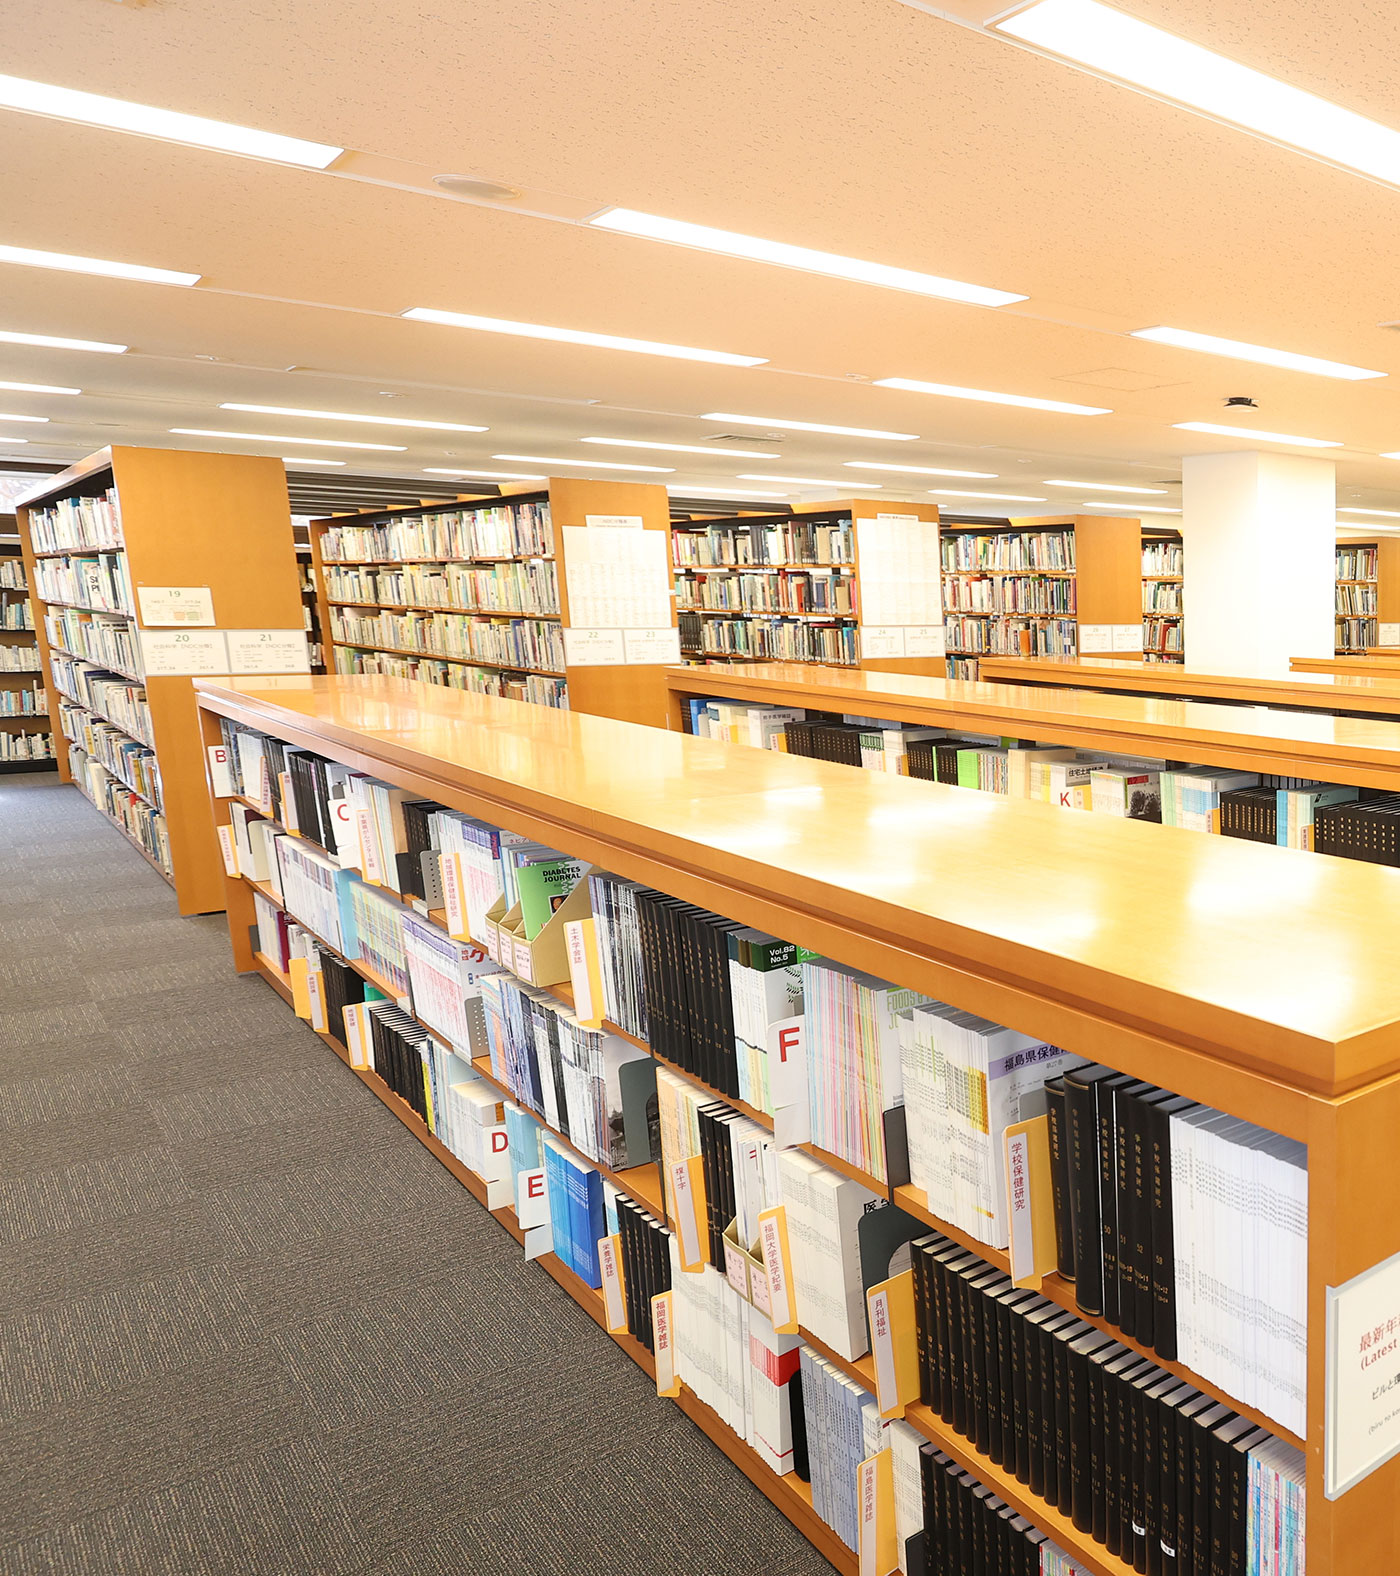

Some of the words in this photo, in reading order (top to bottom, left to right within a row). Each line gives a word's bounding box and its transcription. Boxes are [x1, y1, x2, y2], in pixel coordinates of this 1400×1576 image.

[169, 590, 181, 598] 19
[175, 634, 190, 642] 20
[260, 634, 273, 642] 21
[215, 750, 227, 763] B
[1060, 791, 1071, 808] K
[337, 803, 350, 822] C
[542, 865, 581, 877] DIABETES
[543, 873, 582, 883] JOURNAL
[769, 945, 796, 956] Vol.82
[770, 953, 789, 965] No.5
[778, 1027, 800, 1063] F
[1004, 1043, 1070, 1072] 福島県保健
[492, 1131, 509, 1154] D
[1011, 1141, 1026, 1212] 学校保健研究
[528, 1174, 545, 1199] E
[764, 1223, 782, 1293] 福岡大学医学紀要
[655, 1301, 669, 1350] 福岡医学雑誌
[875, 1298, 887, 1337] 月刊福祉
[1360, 1338, 1397, 1371] (Latest
